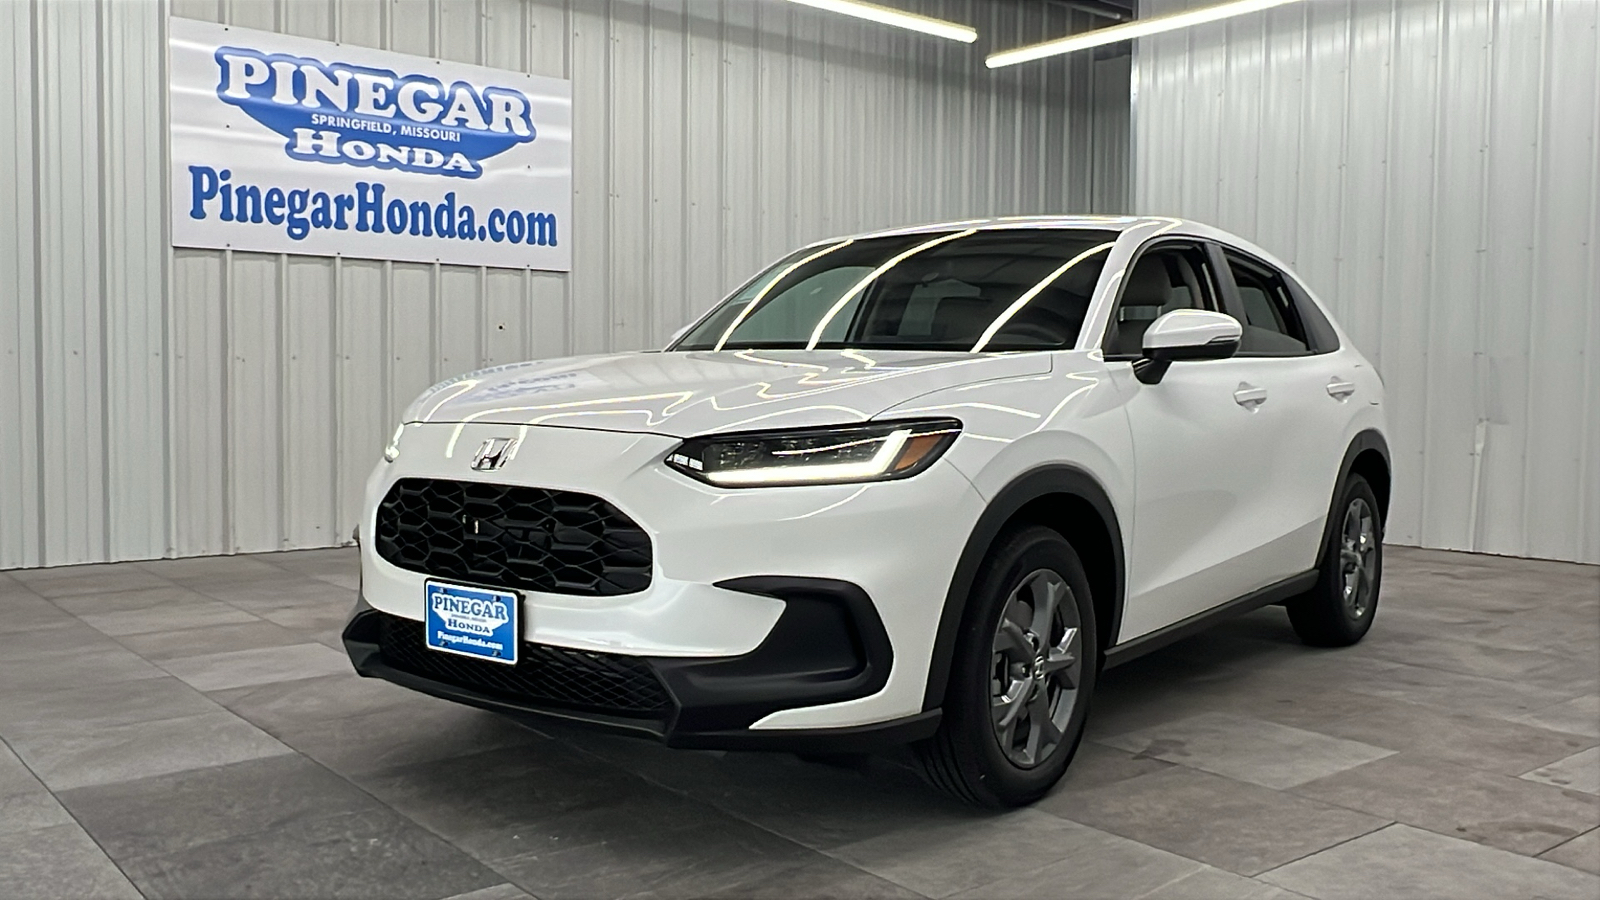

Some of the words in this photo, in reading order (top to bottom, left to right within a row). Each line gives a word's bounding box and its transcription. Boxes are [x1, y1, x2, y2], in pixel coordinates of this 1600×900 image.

[222, 54, 532, 137] PINEGAR
[311, 113, 398, 137] SPRINGFIELD,
[400, 125, 461, 142] MISSOURI
[292, 127, 477, 173] HONDA
[188, 165, 558, 248] PinegarHonda.com
[434, 596, 506, 620] PINEGAR
[447, 618, 490, 633] HONDA
